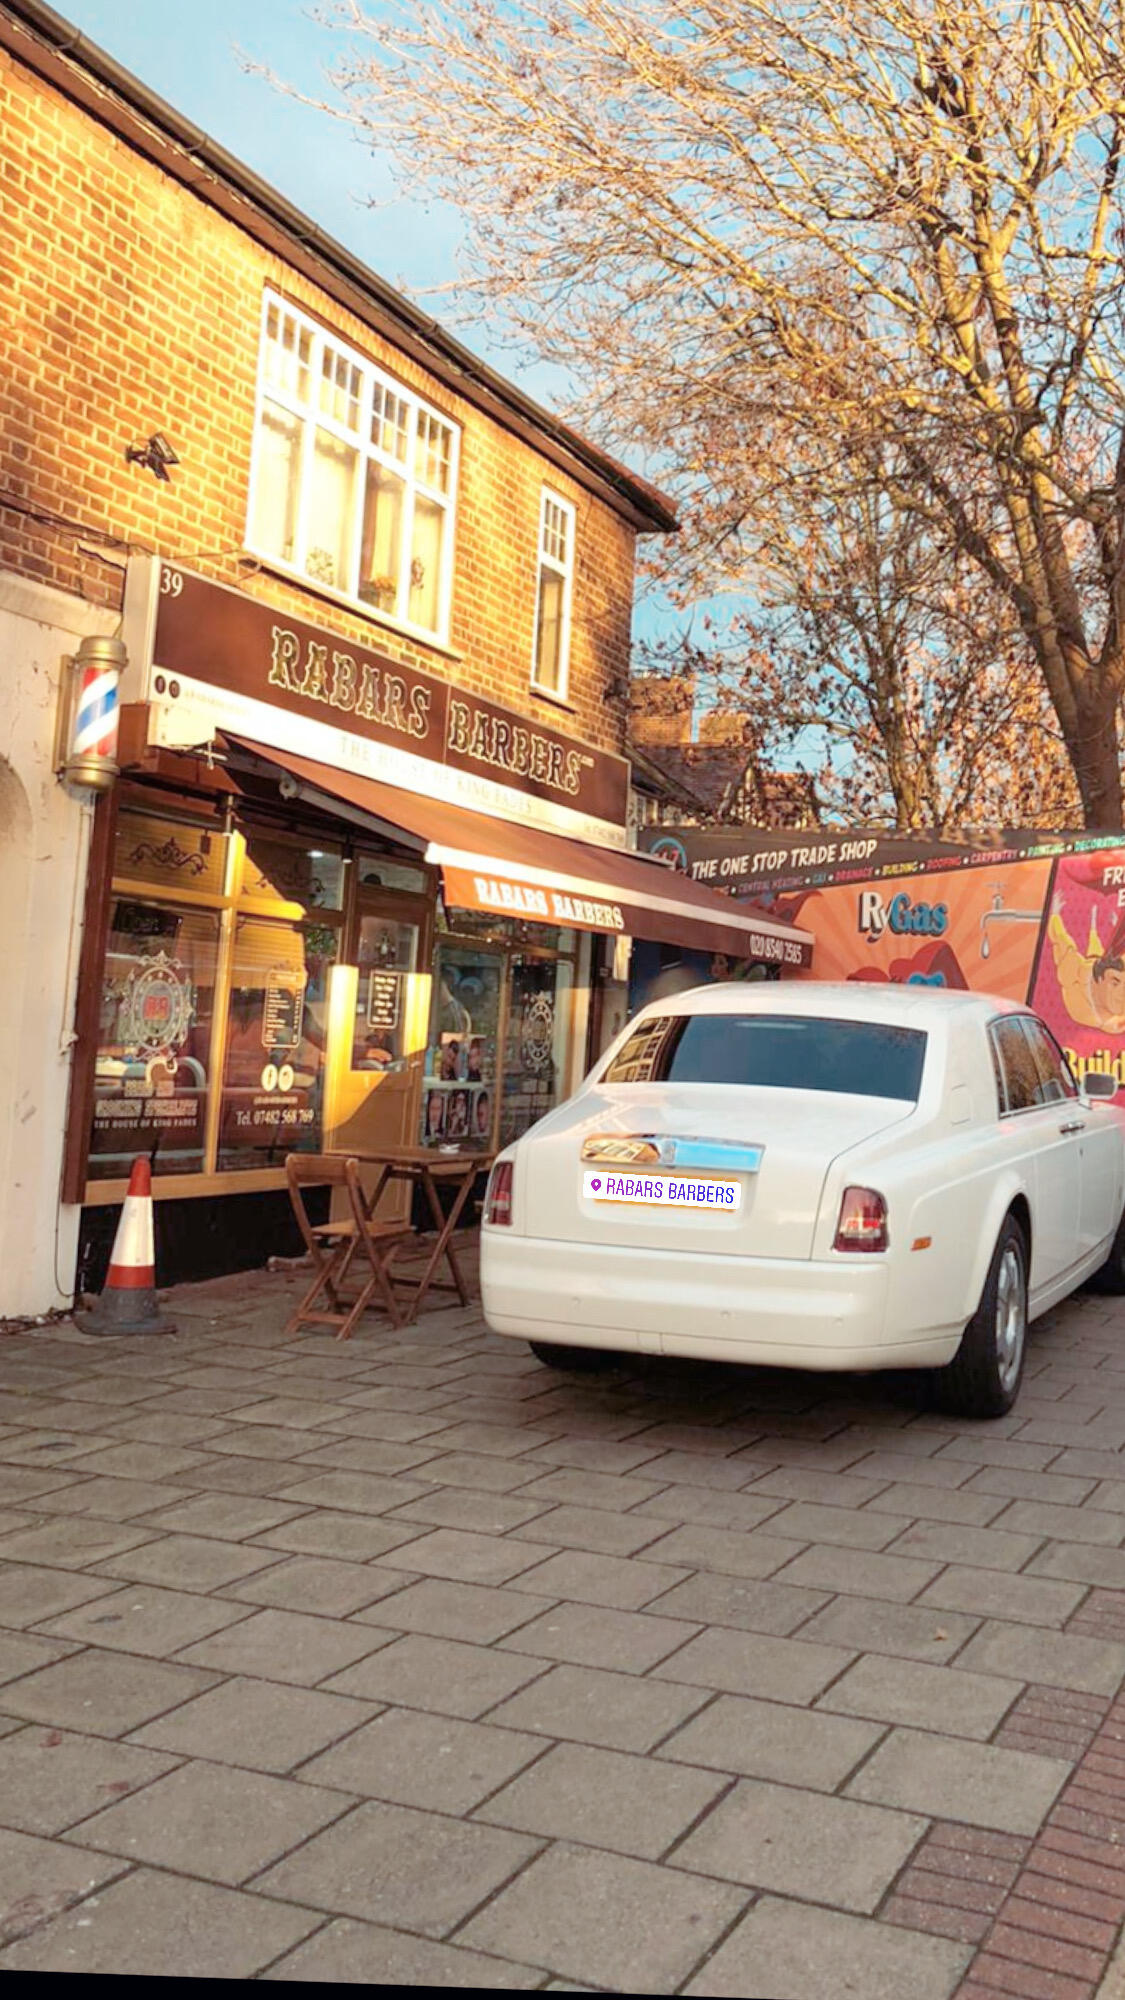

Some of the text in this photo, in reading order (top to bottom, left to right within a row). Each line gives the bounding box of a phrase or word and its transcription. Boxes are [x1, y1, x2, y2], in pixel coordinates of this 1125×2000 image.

[160, 568, 184, 597] 39
[268, 625, 583, 796] RABARS BARBERS
[692, 839, 878, 880] THE ONE STOP TRADE SHOP
[970, 849, 1018, 864] CARPENTRY
[473, 877, 625, 930] RABARS BARBERS
